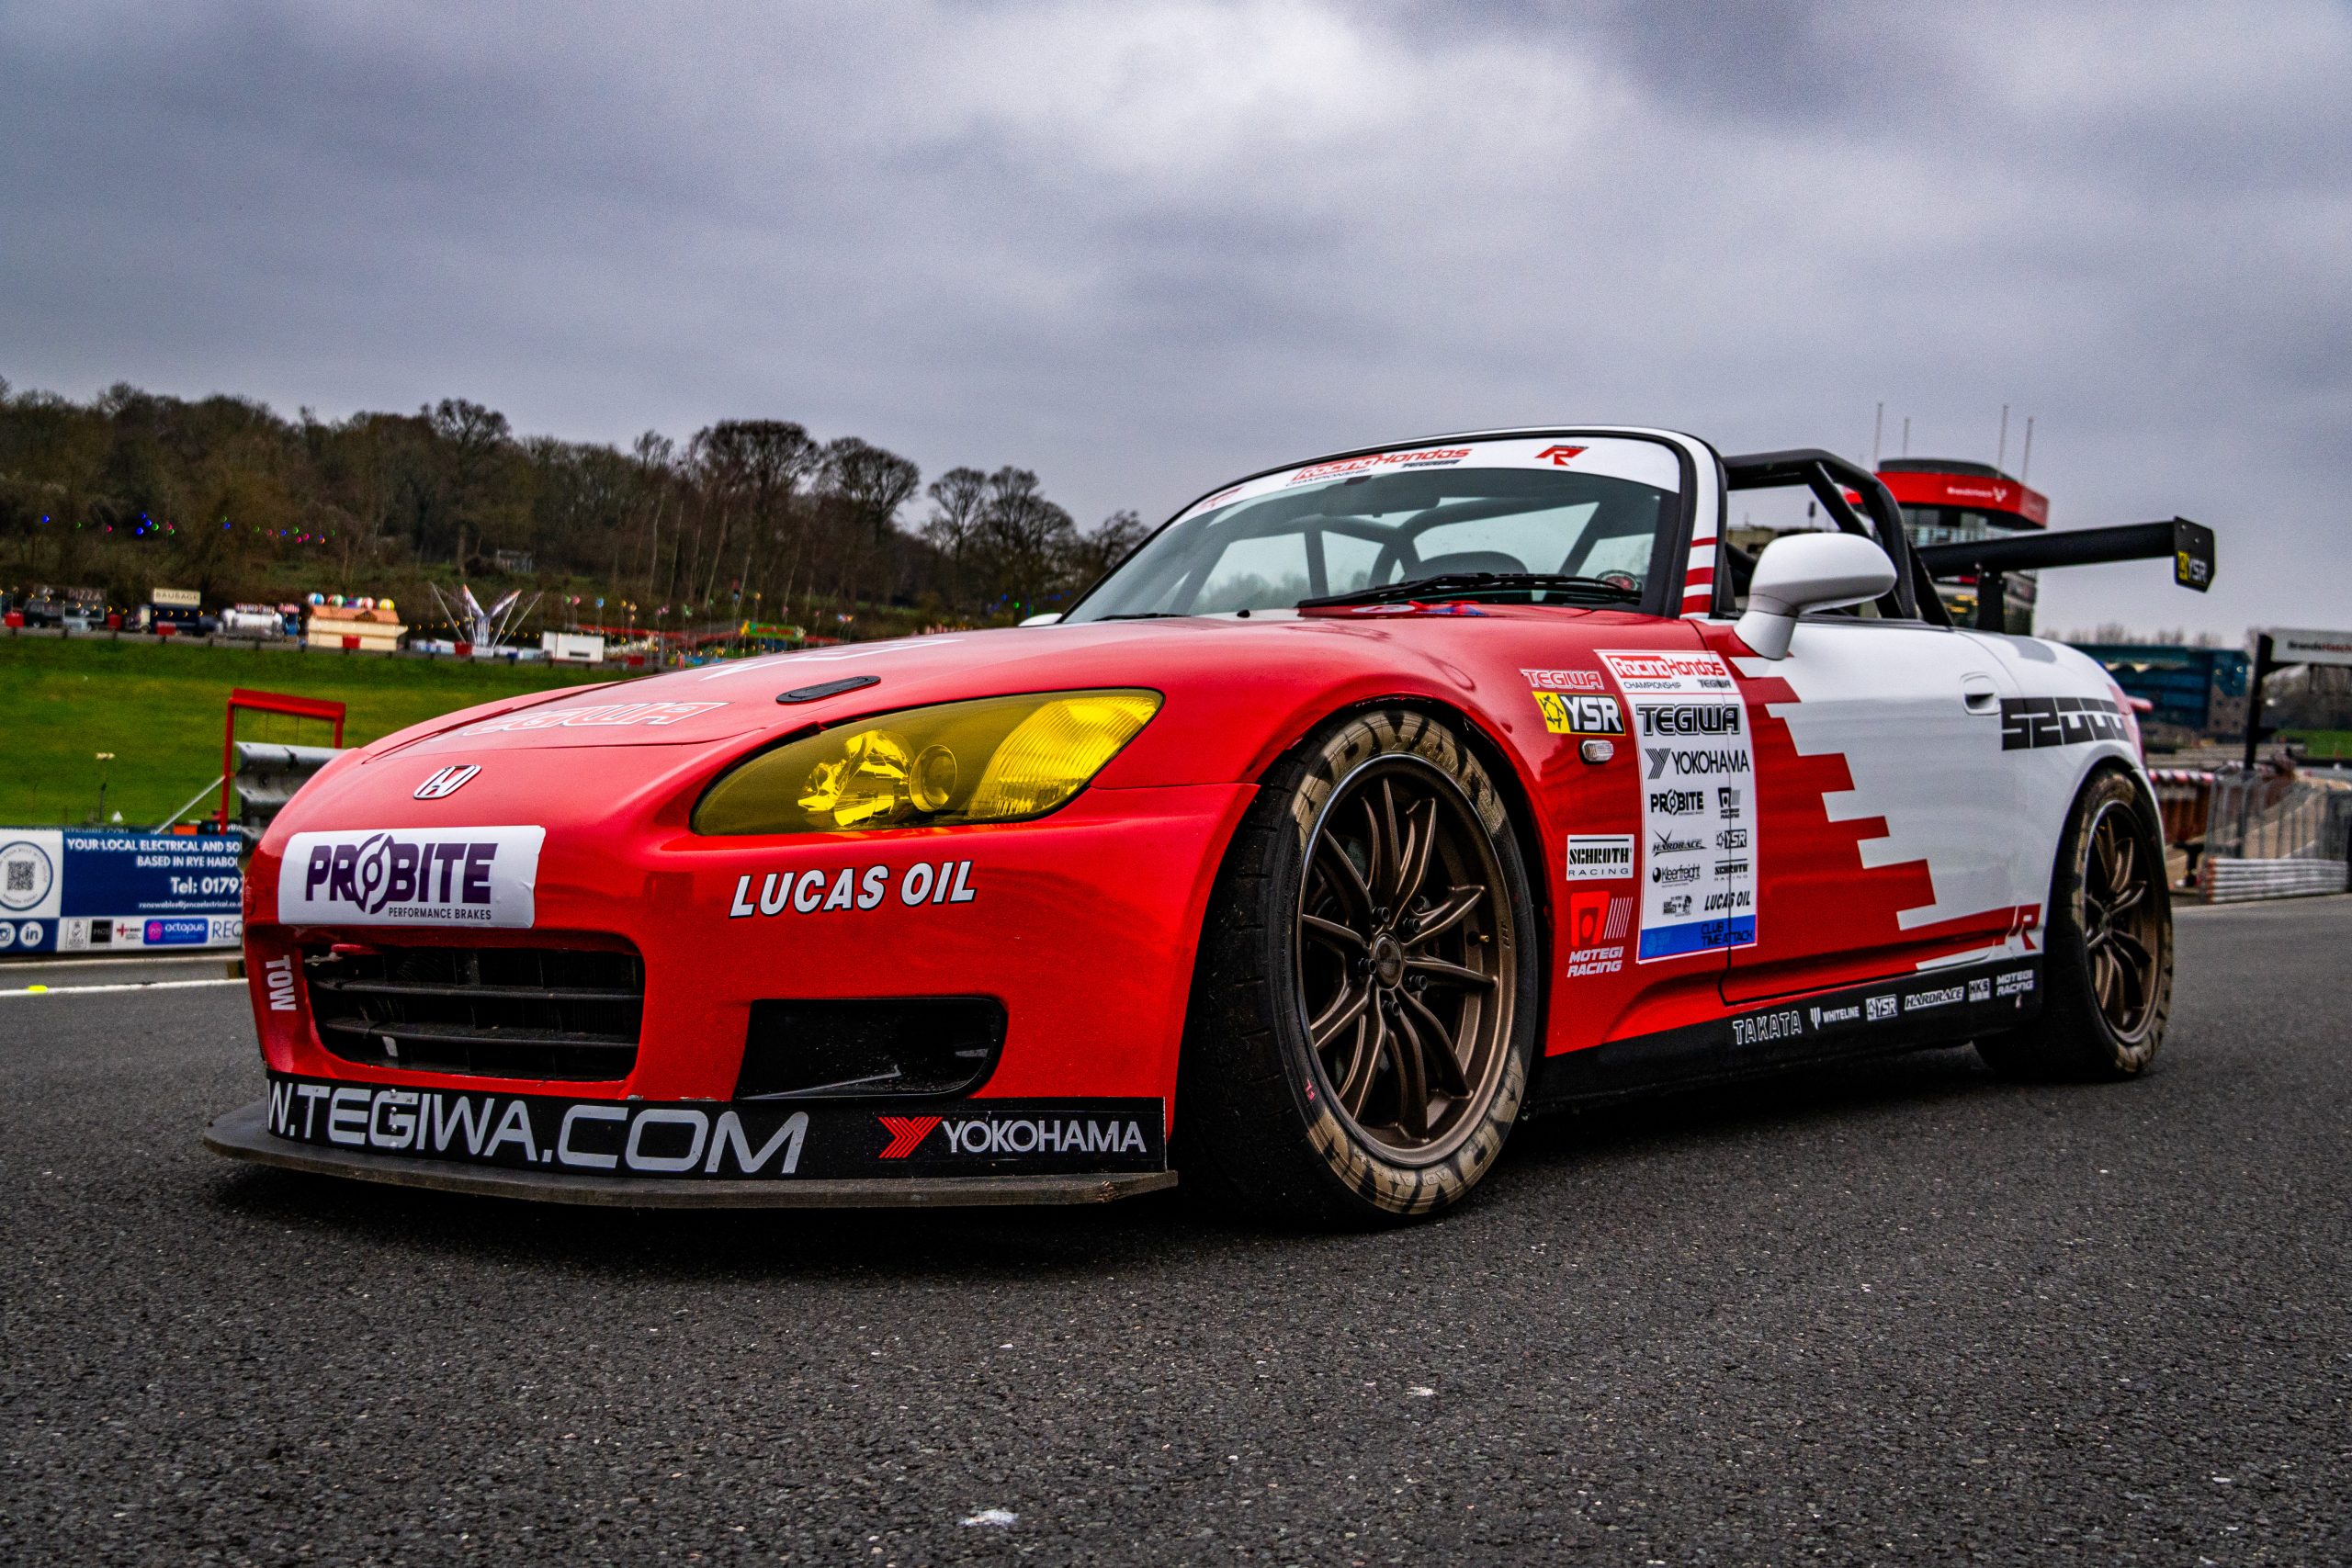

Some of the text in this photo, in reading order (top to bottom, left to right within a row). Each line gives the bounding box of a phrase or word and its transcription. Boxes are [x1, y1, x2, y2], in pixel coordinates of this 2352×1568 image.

[1521, 669, 1605, 691] TEGIWA
[1623, 681, 1682, 690] CHAMPIONSHIP
[1697, 679, 1732, 689] TEGIWA
[1560, 695, 1623, 732] YSR
[1635, 703, 1741, 737] TEGIWA
[1671, 750, 1751, 774] YOKOHAMA
[1650, 788, 1704, 816] PROBITE
[67, 838, 99, 851] YOUR
[102, 839, 138, 852] LOCAL
[140, 840, 200, 852] ELECTRICAL
[202, 840, 224, 852] AND
[1653, 838, 1703, 852] HARDRACE
[1724, 829, 1747, 849] YSR
[137, 855, 170, 867] BASED
[173, 856, 184, 867] IN
[187, 856, 205, 867] RYE
[1568, 847, 1630, 865] SCHROTH
[305, 832, 499, 915] PROBITE
[1568, 868, 1630, 877] RACING
[170, 876, 198, 895] Tel:
[729, 860, 978, 919] LUCAS OIL
[1704, 892, 1736, 911] LUCAS
[1736, 891, 1750, 908] OIL
[389, 907, 492, 920] PERFORMANCE BRAKES
[164, 921, 206, 935] octopus
[1701, 921, 1724, 934] CLUB
[1702, 929, 1754, 947] TIME ATTACK
[1568, 946, 1624, 964] MOTEGI
[1566, 960, 1623, 977] RACING
[266, 954, 297, 1011] TOW
[1996, 980, 2034, 997] RACING
[1876, 995, 1897, 1018] YSR
[1905, 987, 1964, 1010] HARDRACE
[1823, 1006, 1860, 1023] WHITELINE
[1732, 1010, 1803, 1045] TAKATA
[943, 1119, 1148, 1154] YOKOHAMA
